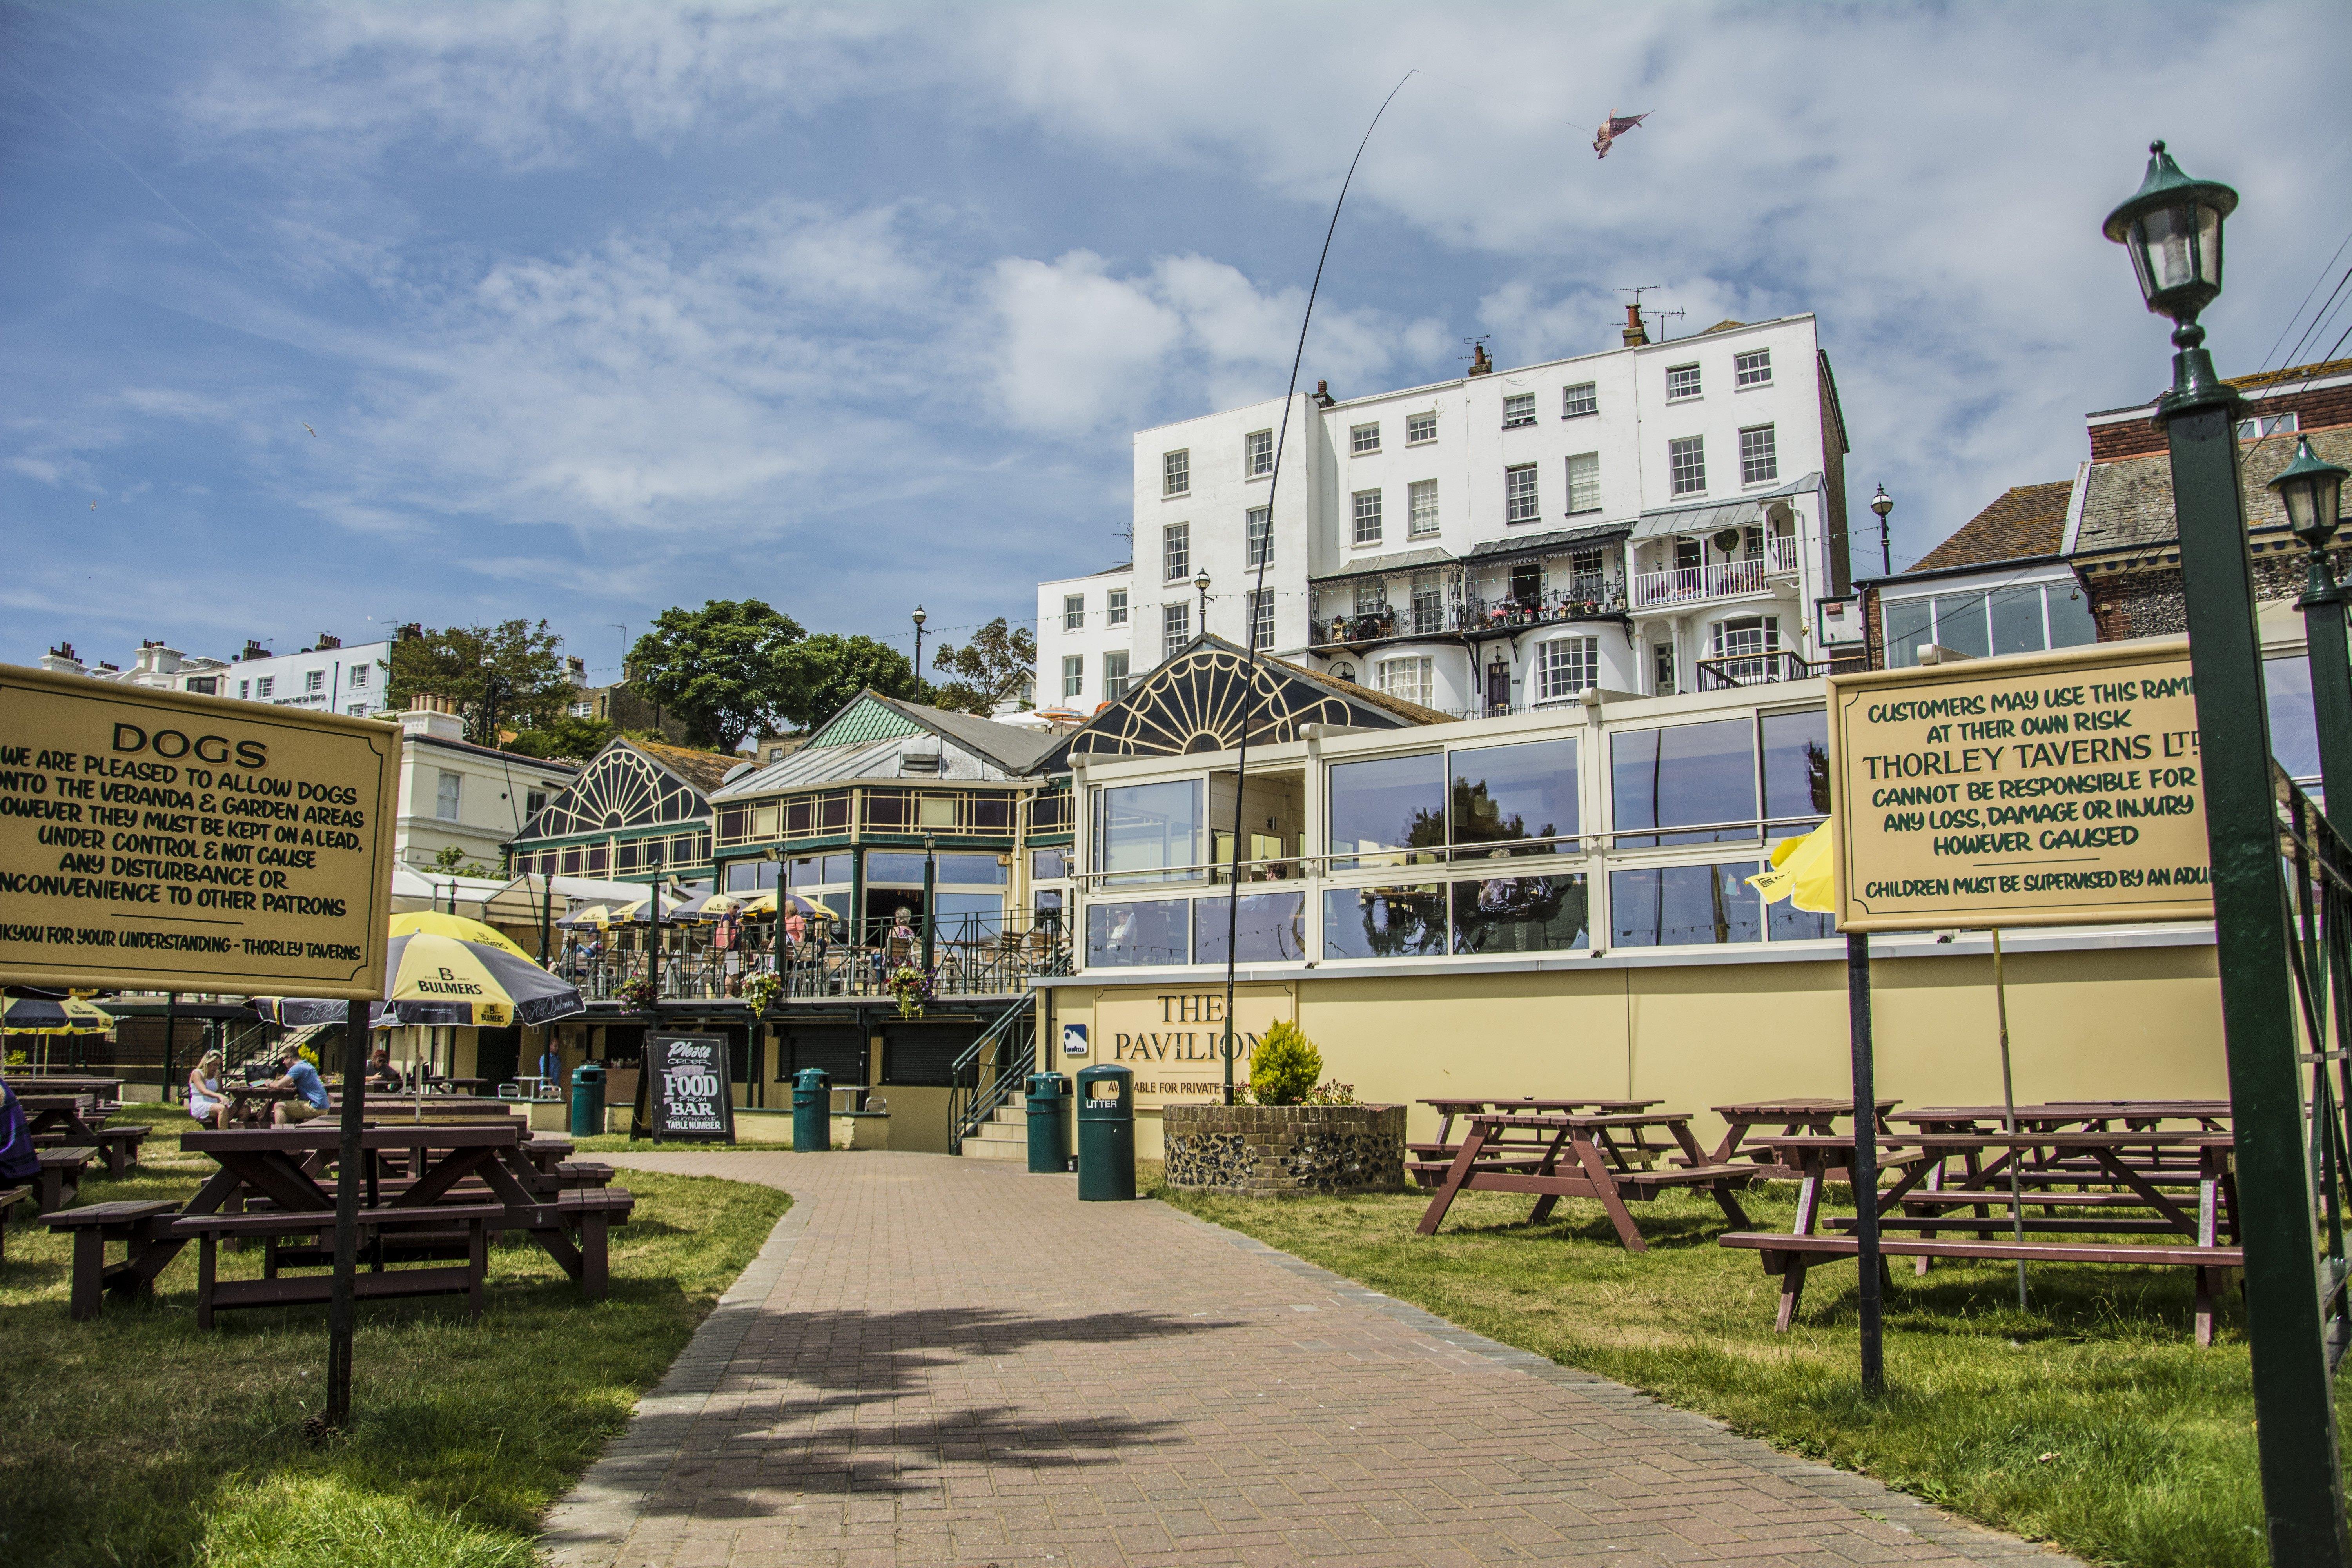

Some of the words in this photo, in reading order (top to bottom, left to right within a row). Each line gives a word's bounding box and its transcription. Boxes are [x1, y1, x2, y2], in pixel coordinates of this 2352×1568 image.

[1868, 695, 1986, 723] CUSTOMERS
[1991, 690, 2038, 713] MAY
[2044, 686, 2085, 708] USE
[2089, 681, 2138, 704] THIS
[1927, 724, 1952, 744] AT
[1957, 719, 2016, 741] THEIR
[2021, 714, 2069, 737] OWN
[2073, 709, 2133, 731] RISK
[112, 722, 268, 769] DOGS
[1862, 746, 2004, 780] THORLEY
[2012, 734, 2152, 768] TAVERNS
[1, 745, 31, 767] WE
[36, 750, 77, 772] ARE
[84, 755, 178, 784] PLEASED
[185, 768, 213, 789] TO
[218, 773, 292, 797] ALLOW
[298, 782, 358, 805] DOGS
[1872, 784, 1960, 808] CANNOT
[1966, 781, 1994, 801] BE
[1998, 771, 2142, 799] RESPONSIBLE
[2149, 767, 2198, 789] FOR
[0, 771, 47, 794] NTO
[55, 777, 95, 799] THE
[101, 782, 194, 811] VERANDA
[199, 793, 216, 813] &
[222, 797, 299, 822] GARDEN
[303, 806, 364, 828] AREAS
[1884, 812, 1924, 833] ANY
[1929, 808, 1986, 830] LOSS,
[1987, 802, 2079, 826] DAMAGE
[2082, 799, 2114, 820] OR
[2116, 794, 2194, 818] INJURY
[0, 796, 83, 823] OWEVER
[89, 805, 138, 828] THEY
[143, 812, 198, 834] MUST
[201, 817, 224, 837] BE
[227, 820, 272, 841] KEPT
[274, 826, 298, 844] ON
[301, 828, 314, 846] A
[316, 829, 363, 854] LEAD,
[1934, 831, 2033, 856] HOWEVER
[2039, 825, 2139, 850] CAUSED
[38, 825, 105, 850] UNDER
[112, 833, 200, 858] CONTROL
[204, 841, 218, 861] &
[221, 842, 255, 864] NOT
[257, 846, 316, 869] CAUSE
[59, 853, 105, 874] ANY
[111, 857, 254, 886] DISTURBANCE
[259, 870, 289, 889] OR
[1865, 878, 1949, 898] CHILDREN
[1953, 876, 1996, 895] MUST
[1999, 875, 2020, 893] BE
[2024, 870, 2117, 892] SUPERVISED
[2119, 869, 2143, 888] BY
[2147, 868, 2171, 887] AN
[2174, 866, 2212, 886] ADU
[0, 872, 161, 903] NCONVENIENCE
[167, 885, 192, 906] TO
[197, 888, 257, 911] OTHER
[262, 893, 346, 917] PATRONS
[0, 924, 44, 943] KYOU
[47, 926, 74, 945] FOR
[76, 928, 116, 947] YOUR
[119, 931, 232, 953] UNDERSTANDING
[242, 938, 303, 957] THORLEY
[306, 942, 361, 961] TAVERNS
[417, 980, 483, 995] BULMERS
[481, 1014, 505, 1022] BULMERS
[1158, 994, 1224, 1022] THE
[668, 1041, 712, 1058] Please
[664, 1074, 718, 1097] FOOD
[673, 1067, 701, 1075] YOUR
[1159, 1083, 1176, 1094] FOR
[1181, 1083, 1220, 1094] PRIVATE
[670, 1102, 716, 1116] BAR
[1086, 1100, 1117, 1108] LITTER
[666, 1120, 689, 1129] TABLE
[689, 1121, 721, 1130] NUMBER
